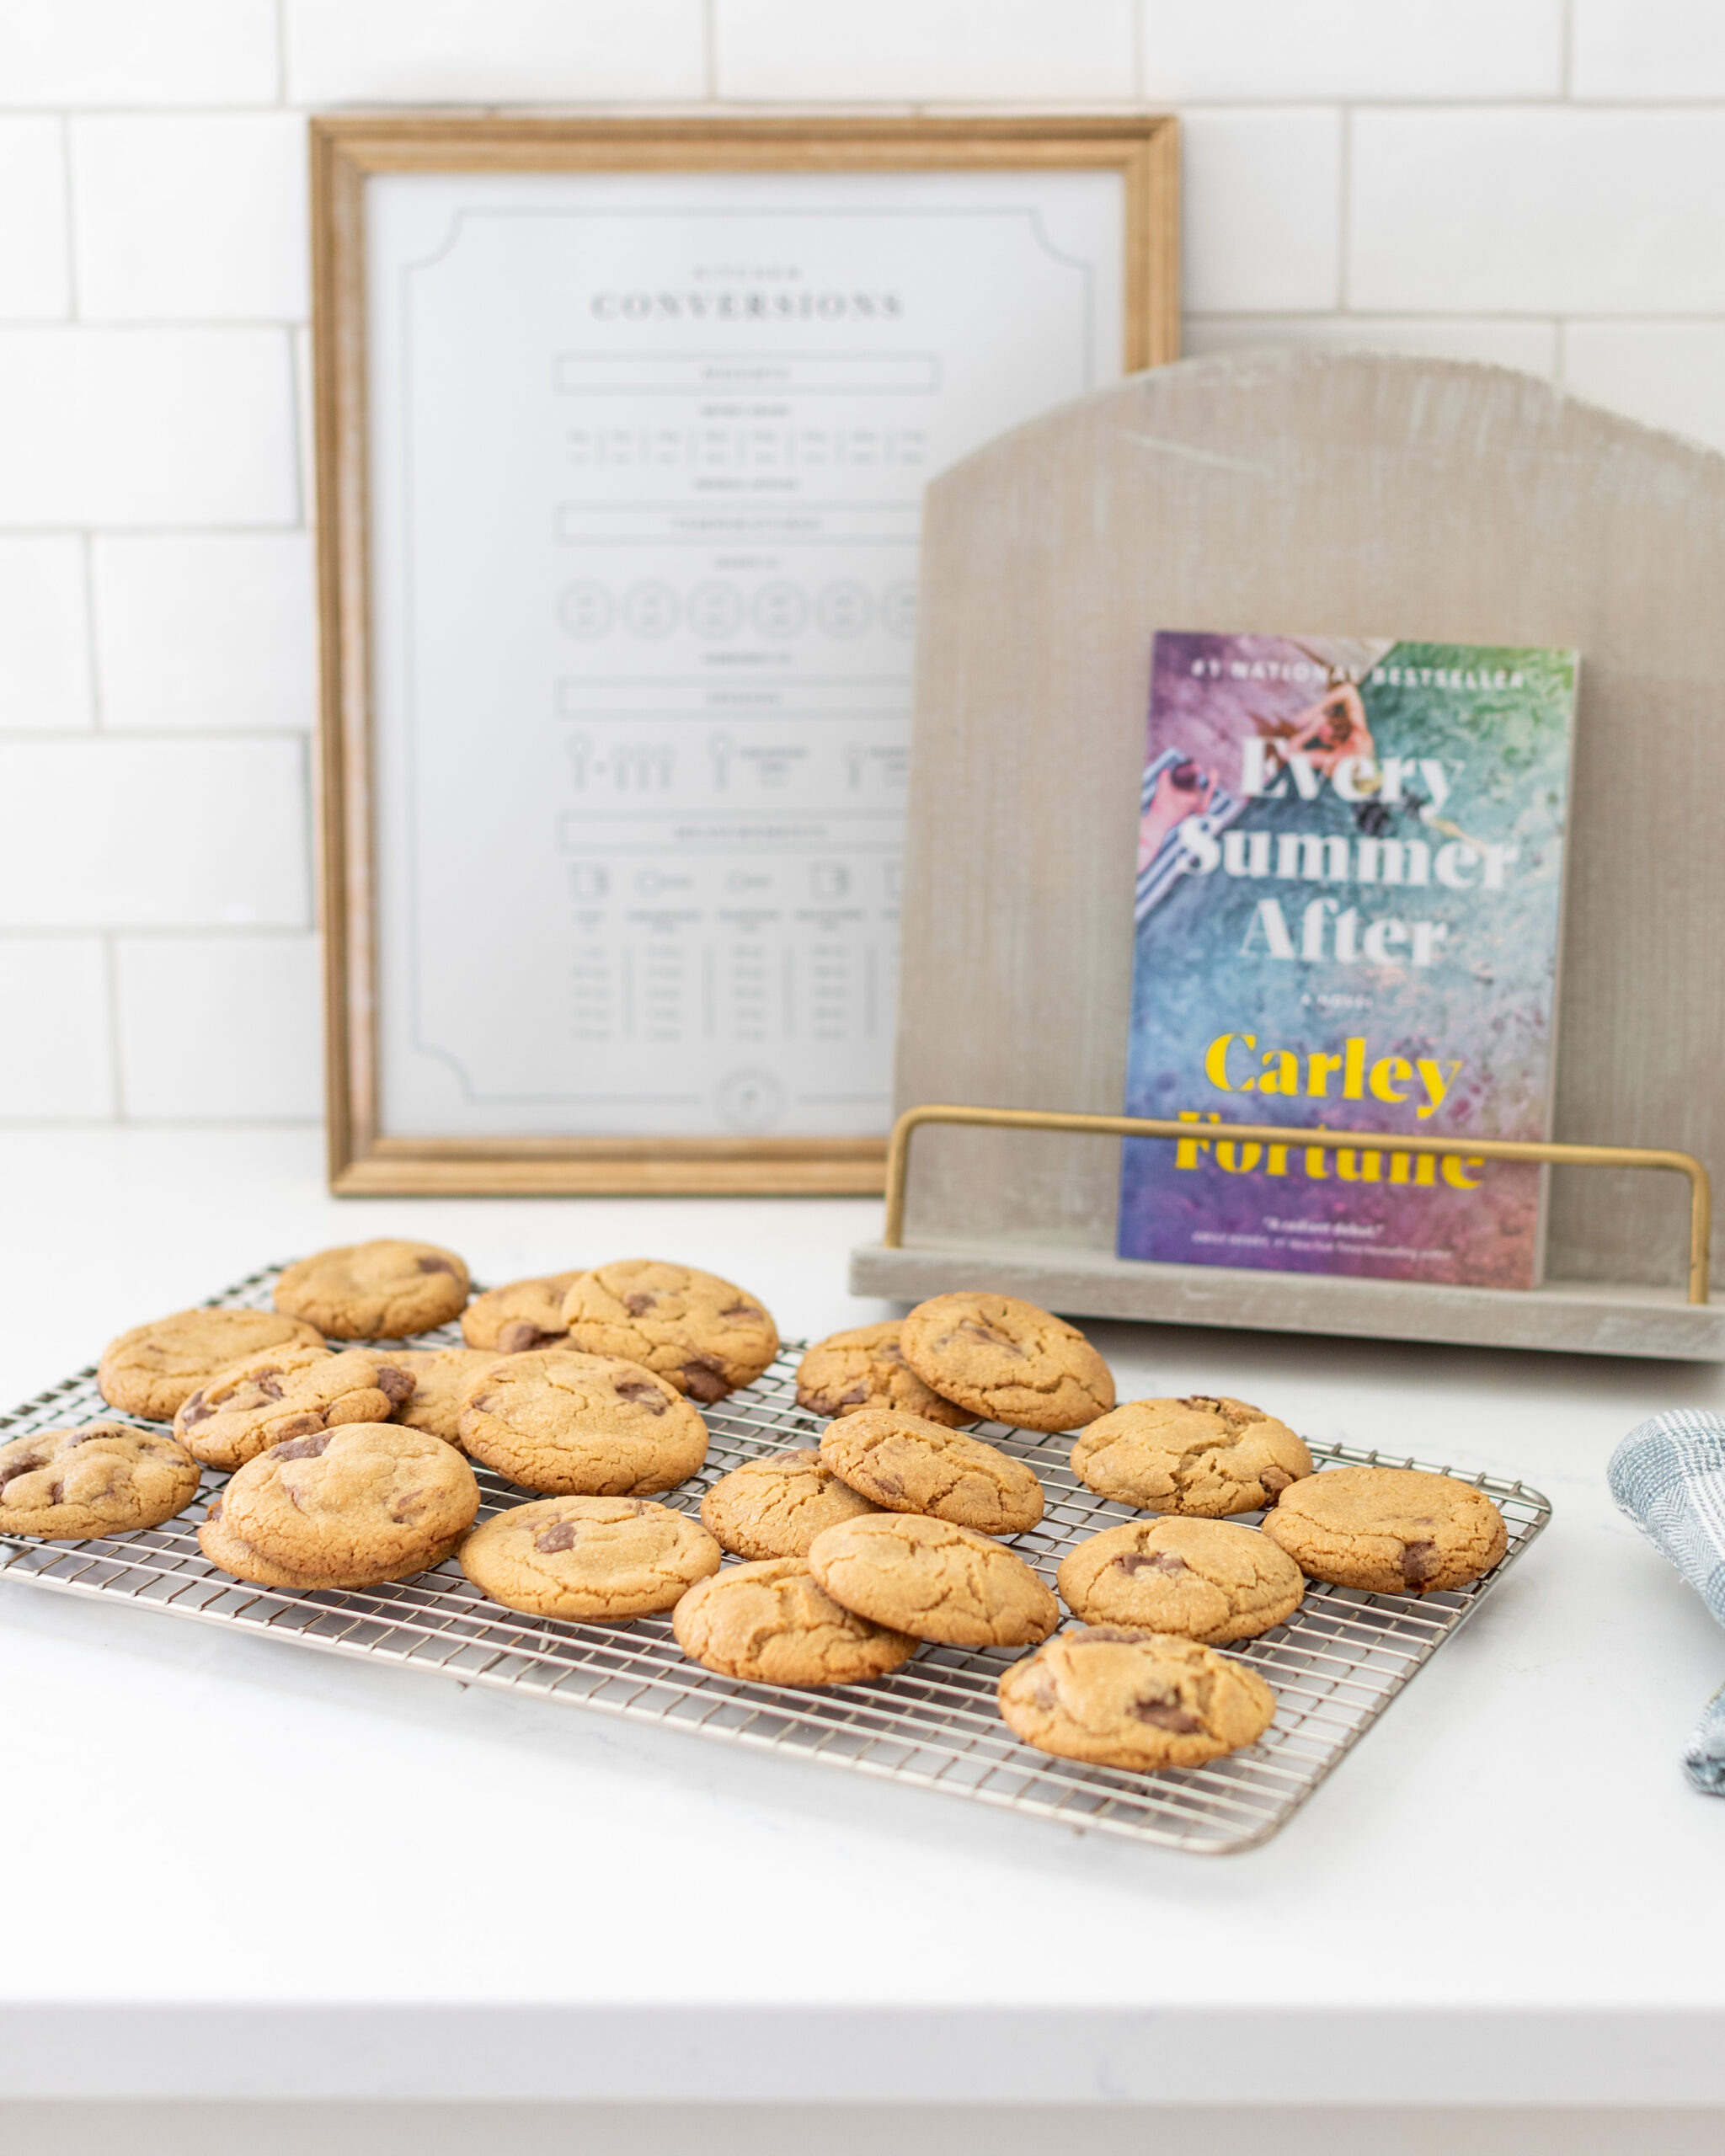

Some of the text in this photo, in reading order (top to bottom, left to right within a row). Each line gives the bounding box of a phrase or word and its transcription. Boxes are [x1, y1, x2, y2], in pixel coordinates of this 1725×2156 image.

[590, 292, 904, 321] CONVERSIONS
[1372, 668, 1524, 690] BESTSELLER
[1239, 735, 1465, 815] Every
[1178, 814, 1520, 889] Summer
[1238, 896, 1449, 967] After
[1204, 1032, 1463, 1119] Carley
[1174, 1110, 1486, 1189] Fortune
